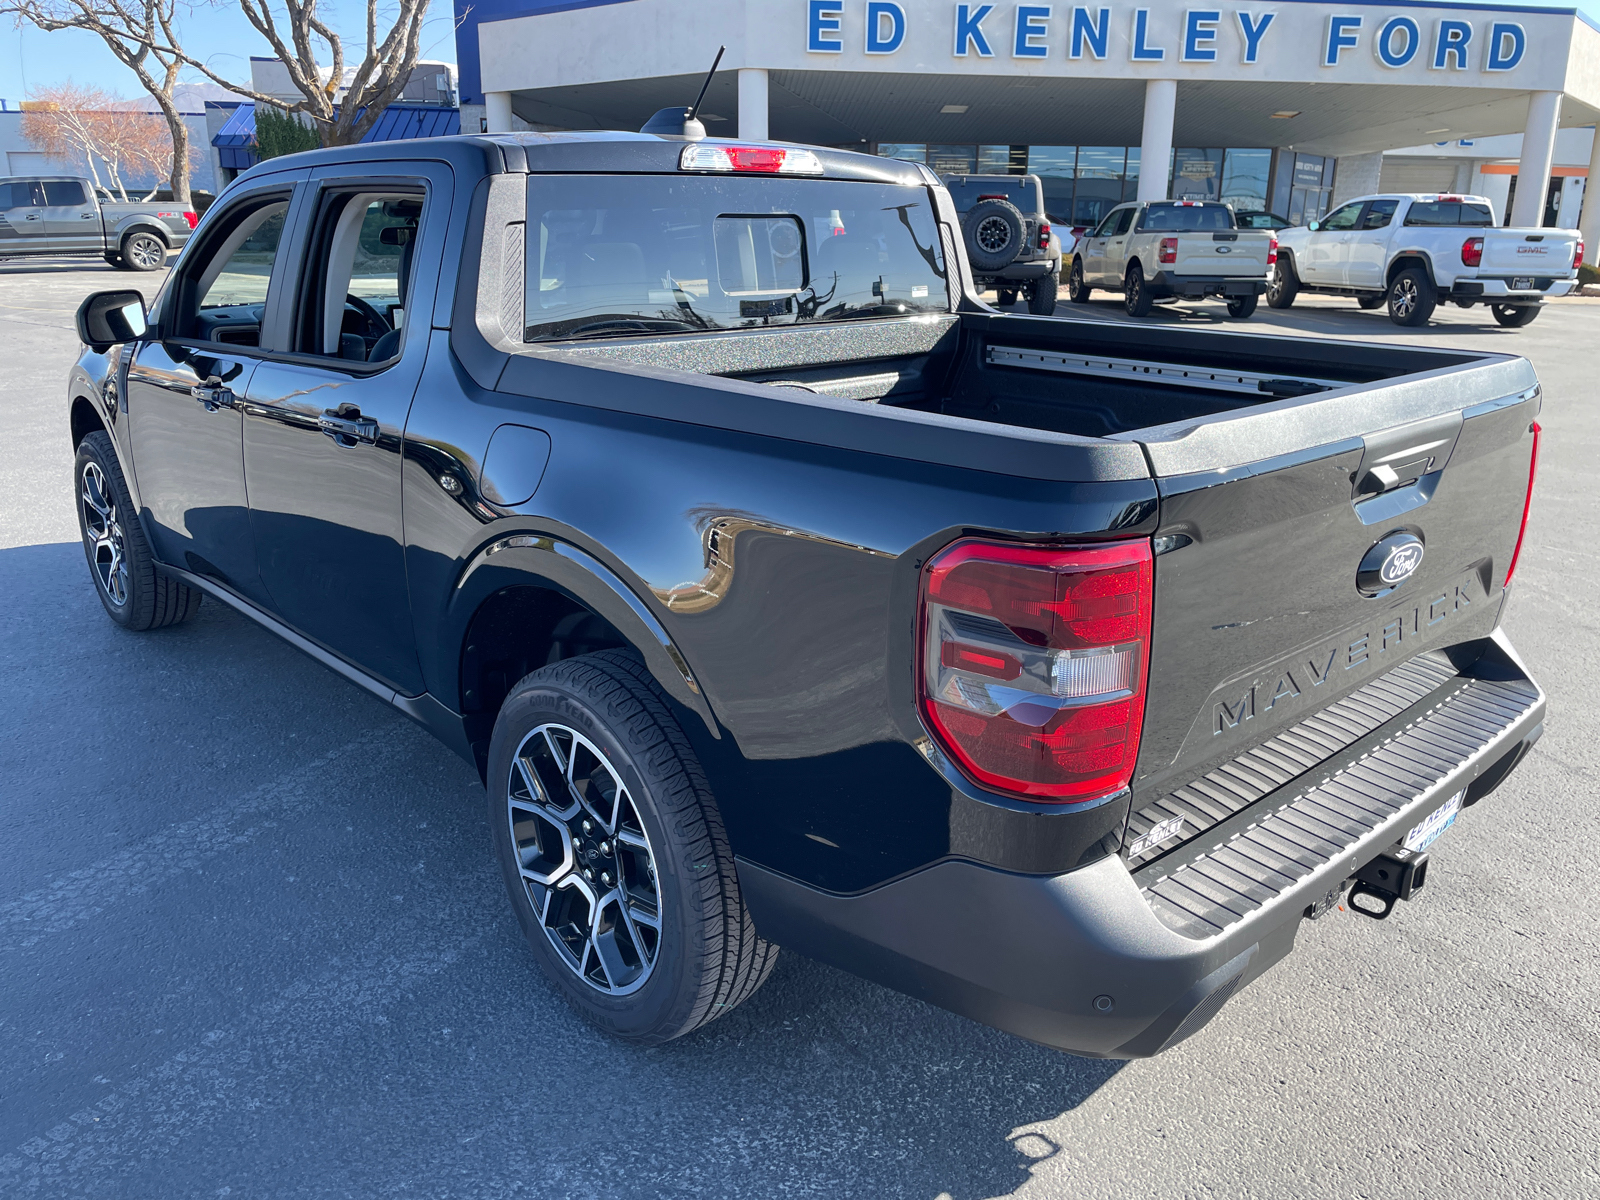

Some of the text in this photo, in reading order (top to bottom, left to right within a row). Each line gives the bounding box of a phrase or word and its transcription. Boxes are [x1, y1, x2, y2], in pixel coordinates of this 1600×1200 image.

[806, 0, 1528, 72] ED KENLEY FORD
[1516, 246, 1549, 254] GMC
[1389, 548, 1418, 579] Ford
[1213, 579, 1471, 736] MAVERICK
[1129, 818, 1184, 856] ED KENLEY
